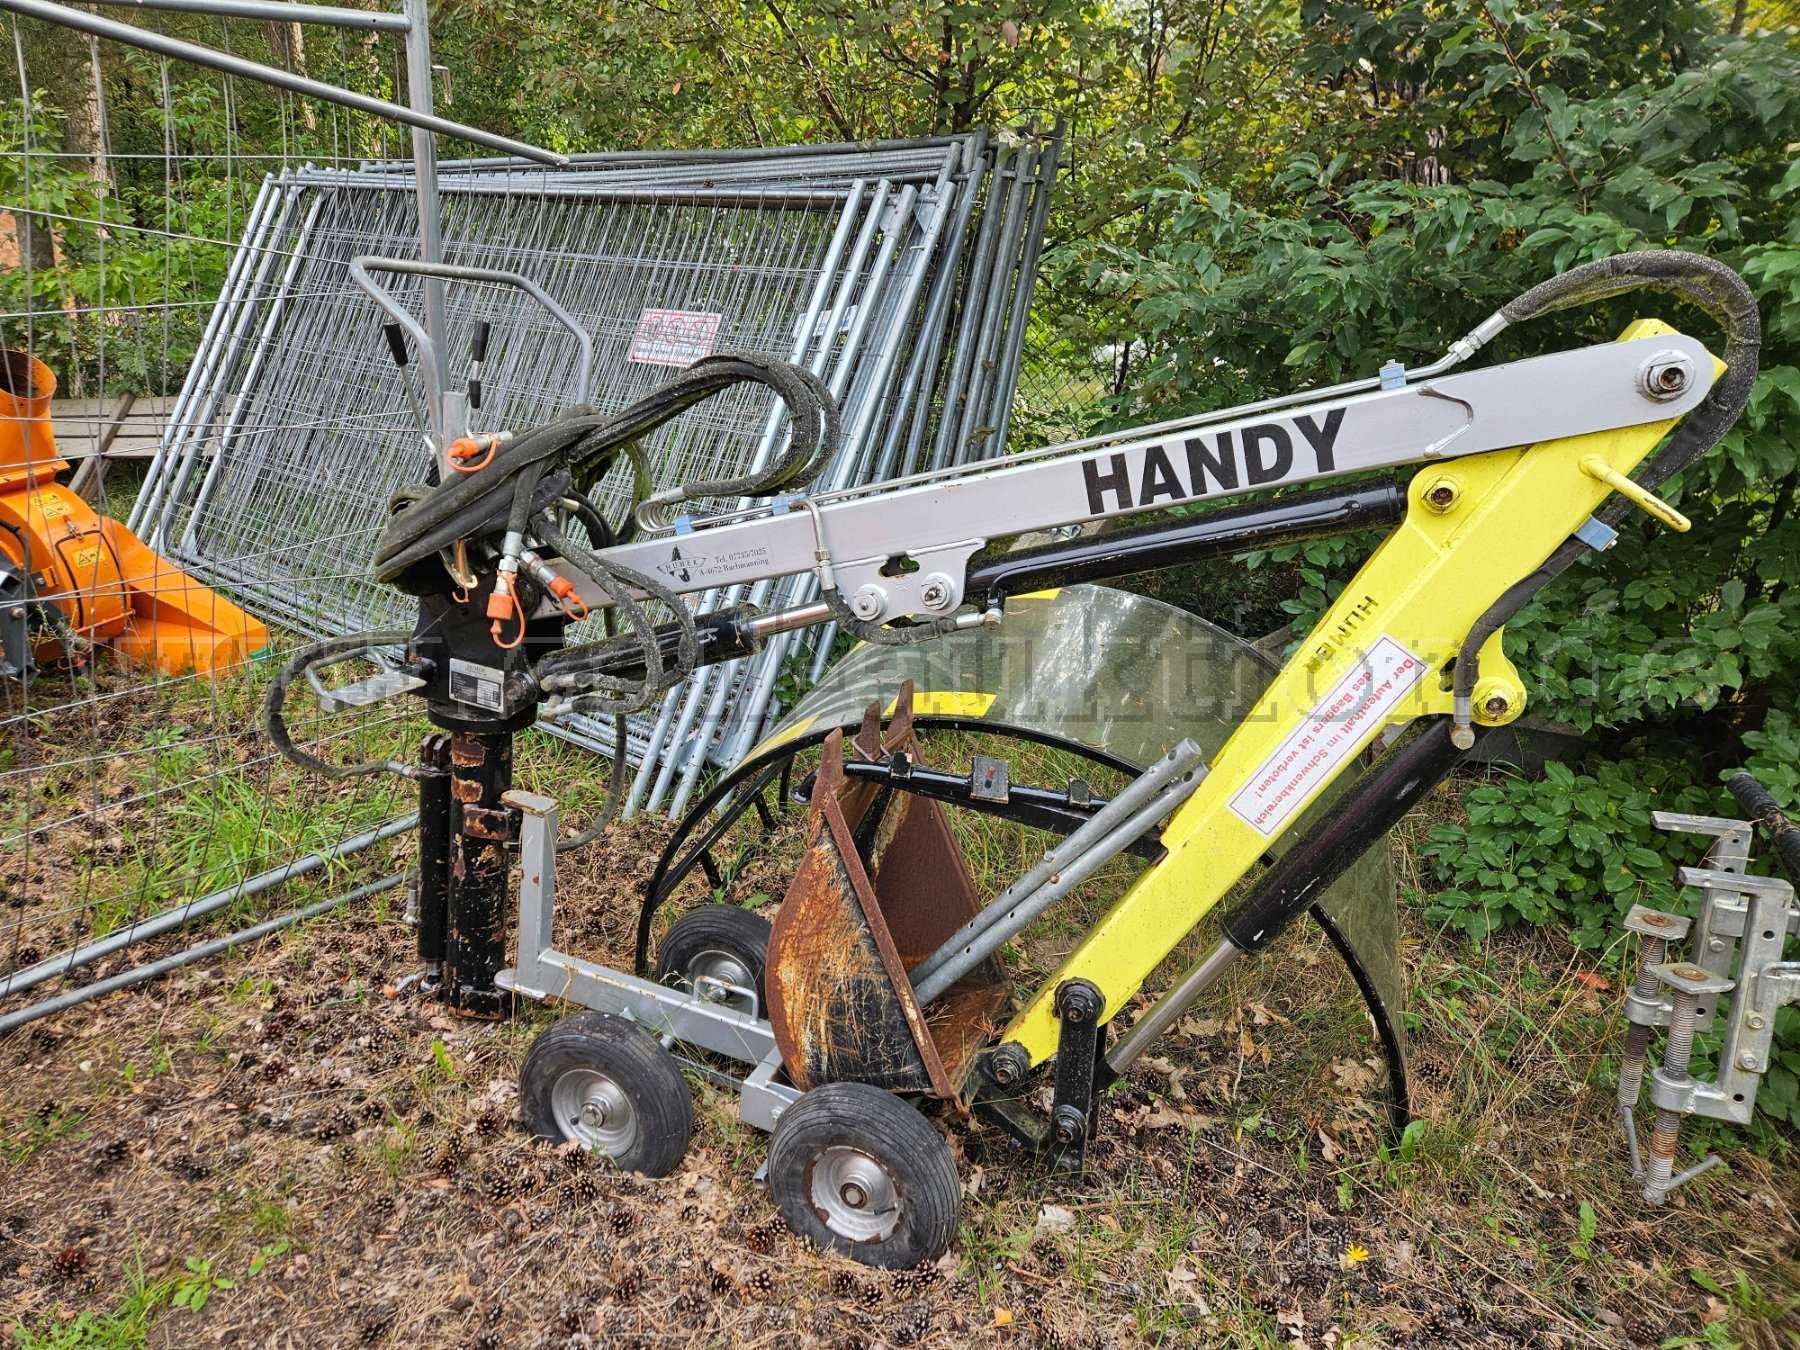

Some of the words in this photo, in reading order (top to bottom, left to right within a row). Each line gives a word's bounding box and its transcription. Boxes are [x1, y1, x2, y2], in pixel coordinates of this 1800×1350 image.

[1082, 407, 1346, 515] HANDY
[1351, 671, 1373, 692] des
[1392, 657, 1415, 680] Der
[1311, 693, 1354, 735] Baggers
[1343, 679, 1393, 735] Aufenthalt
[1298, 734, 1316, 751] ist
[1326, 734, 1344, 748] im
[1253, 748, 1329, 828] Schwenkbereich
[1255, 750, 1299, 798] verboten!
